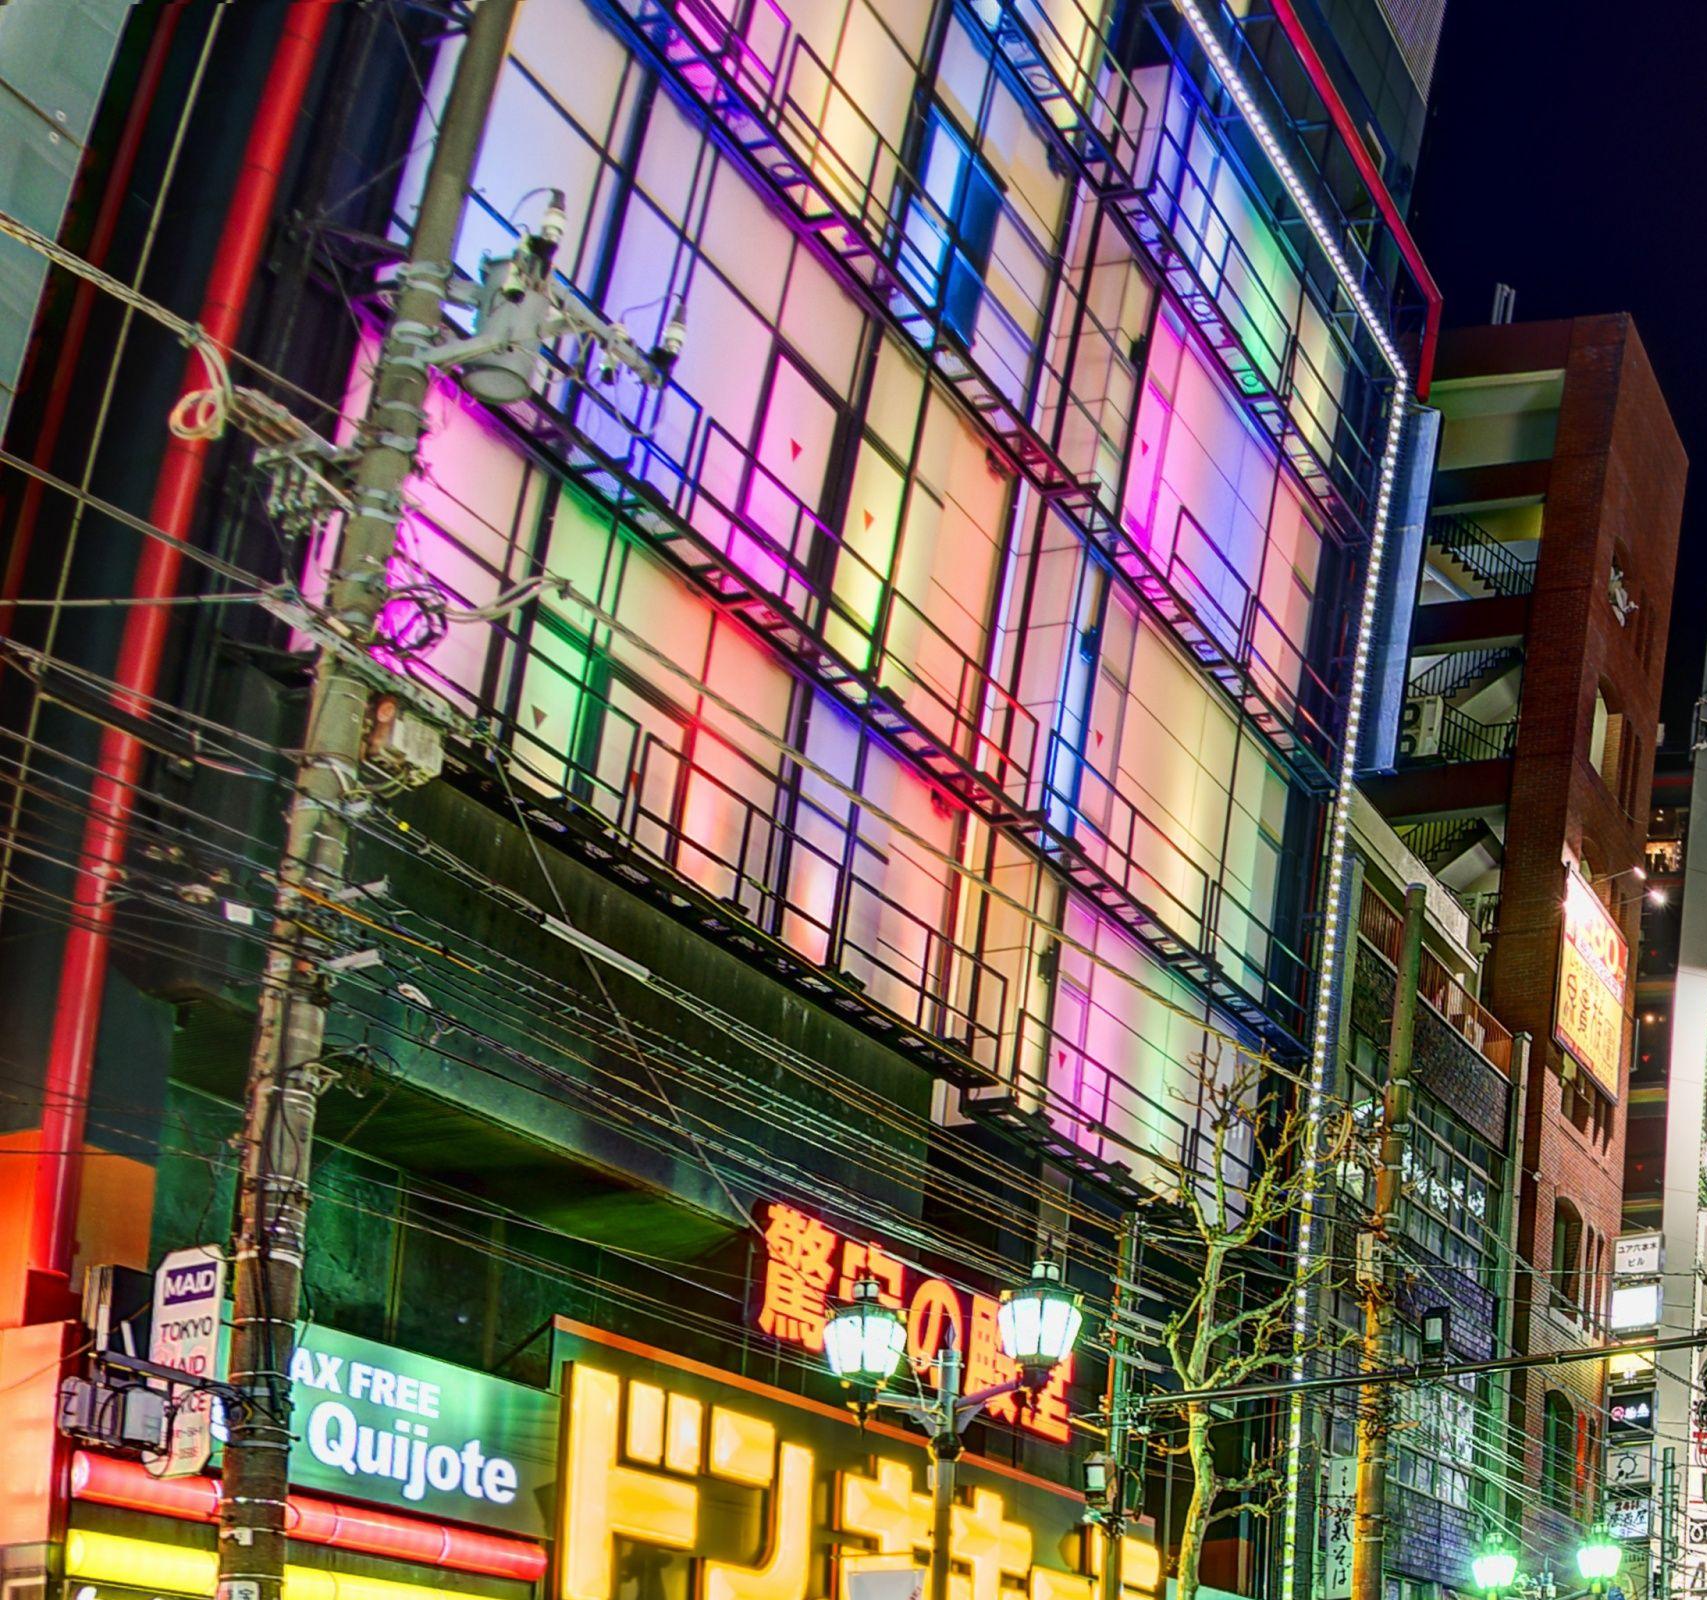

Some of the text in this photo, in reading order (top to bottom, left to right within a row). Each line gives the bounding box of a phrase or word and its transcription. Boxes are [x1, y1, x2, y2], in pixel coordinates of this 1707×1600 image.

[164, 1269, 216, 1299] MAID
[160, 1316, 213, 1344] TOKYO
[289, 1347, 441, 1419] AX FREE
[307, 1400, 519, 1505] Quijote
